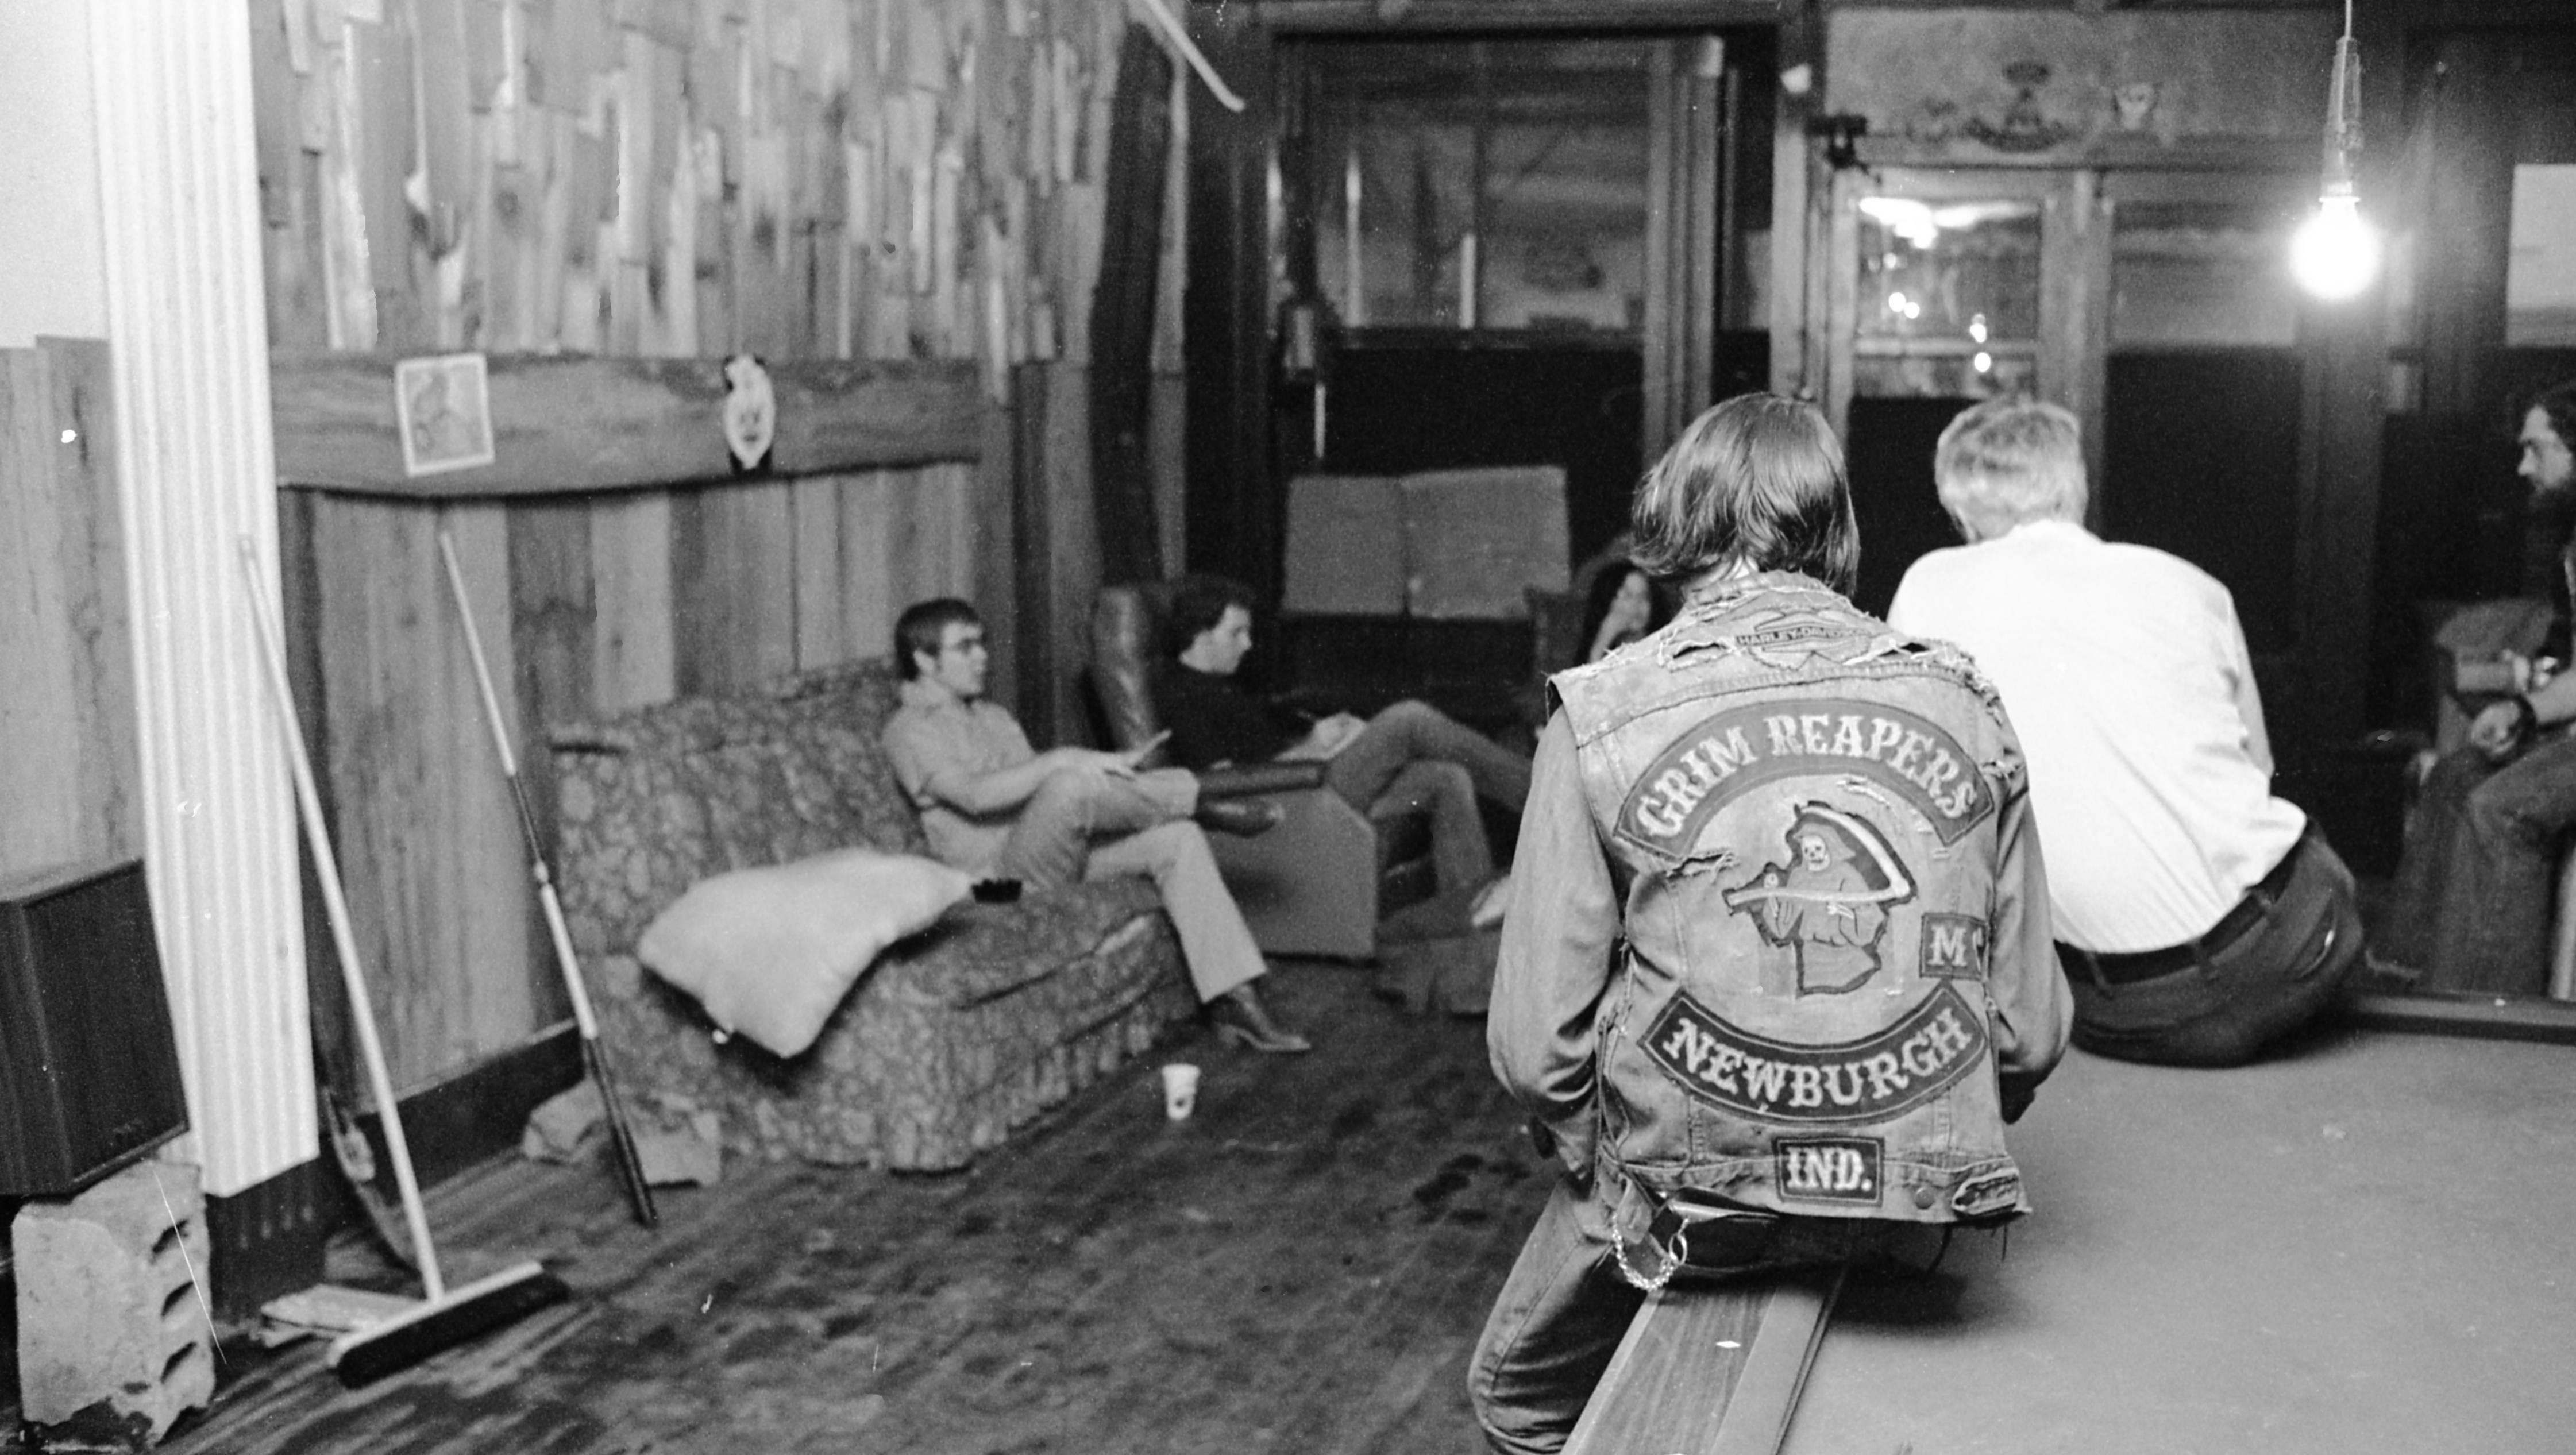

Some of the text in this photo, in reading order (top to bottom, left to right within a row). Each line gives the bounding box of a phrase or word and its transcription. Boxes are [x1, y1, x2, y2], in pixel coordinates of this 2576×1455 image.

[1636, 713, 1977, 837] GRIM REAPERS
[1663, 1007, 1972, 1107] NEWBURGH
[1786, 1147, 1873, 1192] IND.
